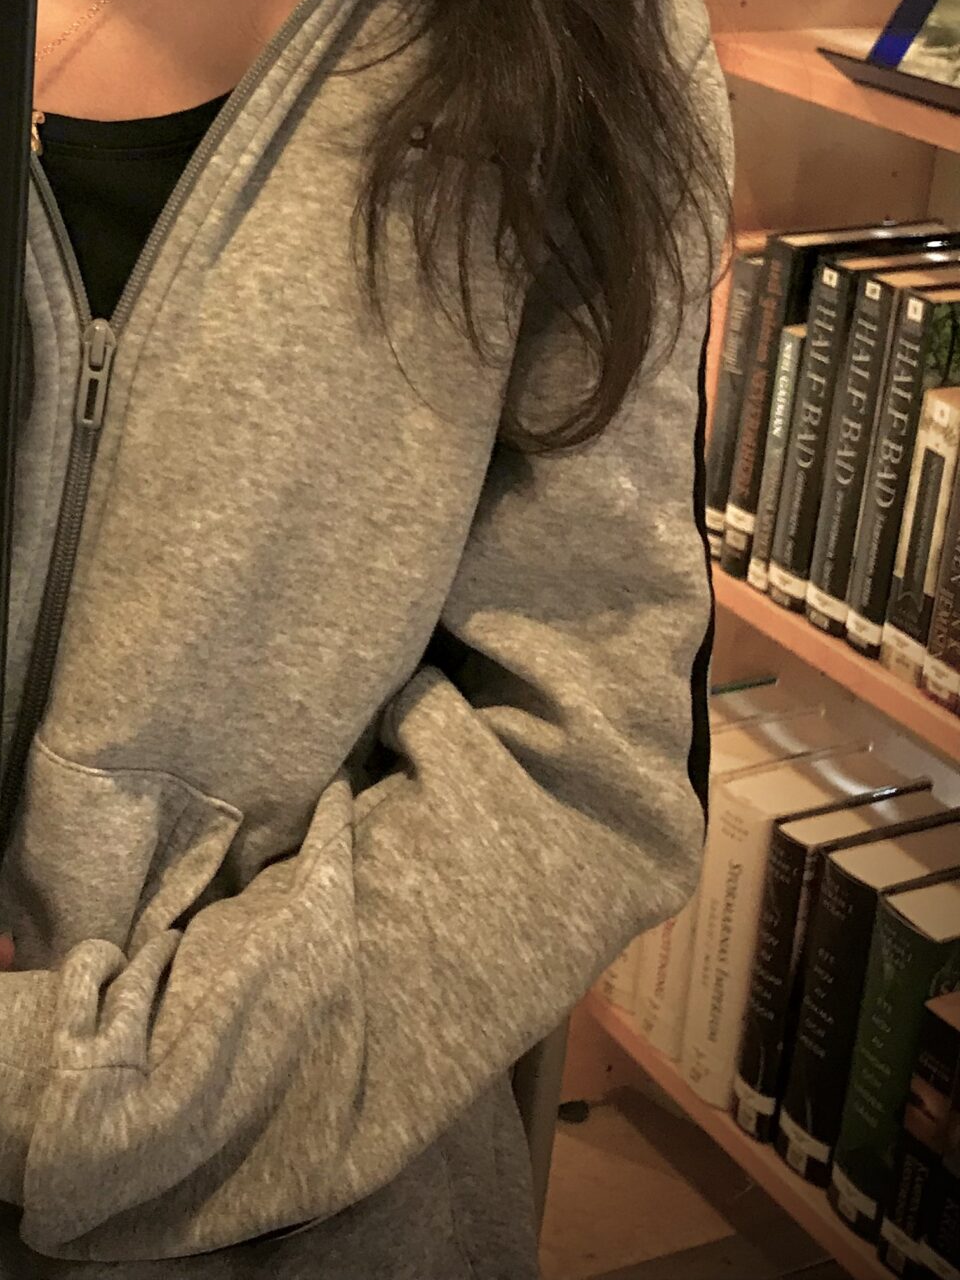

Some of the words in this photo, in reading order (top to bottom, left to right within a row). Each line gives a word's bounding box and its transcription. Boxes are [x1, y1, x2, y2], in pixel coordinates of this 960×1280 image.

[805, 305, 837, 398] HALF
[845, 317, 879, 414] HALF
[887, 338, 921, 435] HALF
[771, 376, 789, 438] GAIMAN
[792, 401, 822, 469] BAD
[832, 416, 863, 485] BAD
[873, 438, 904, 509] BAD
